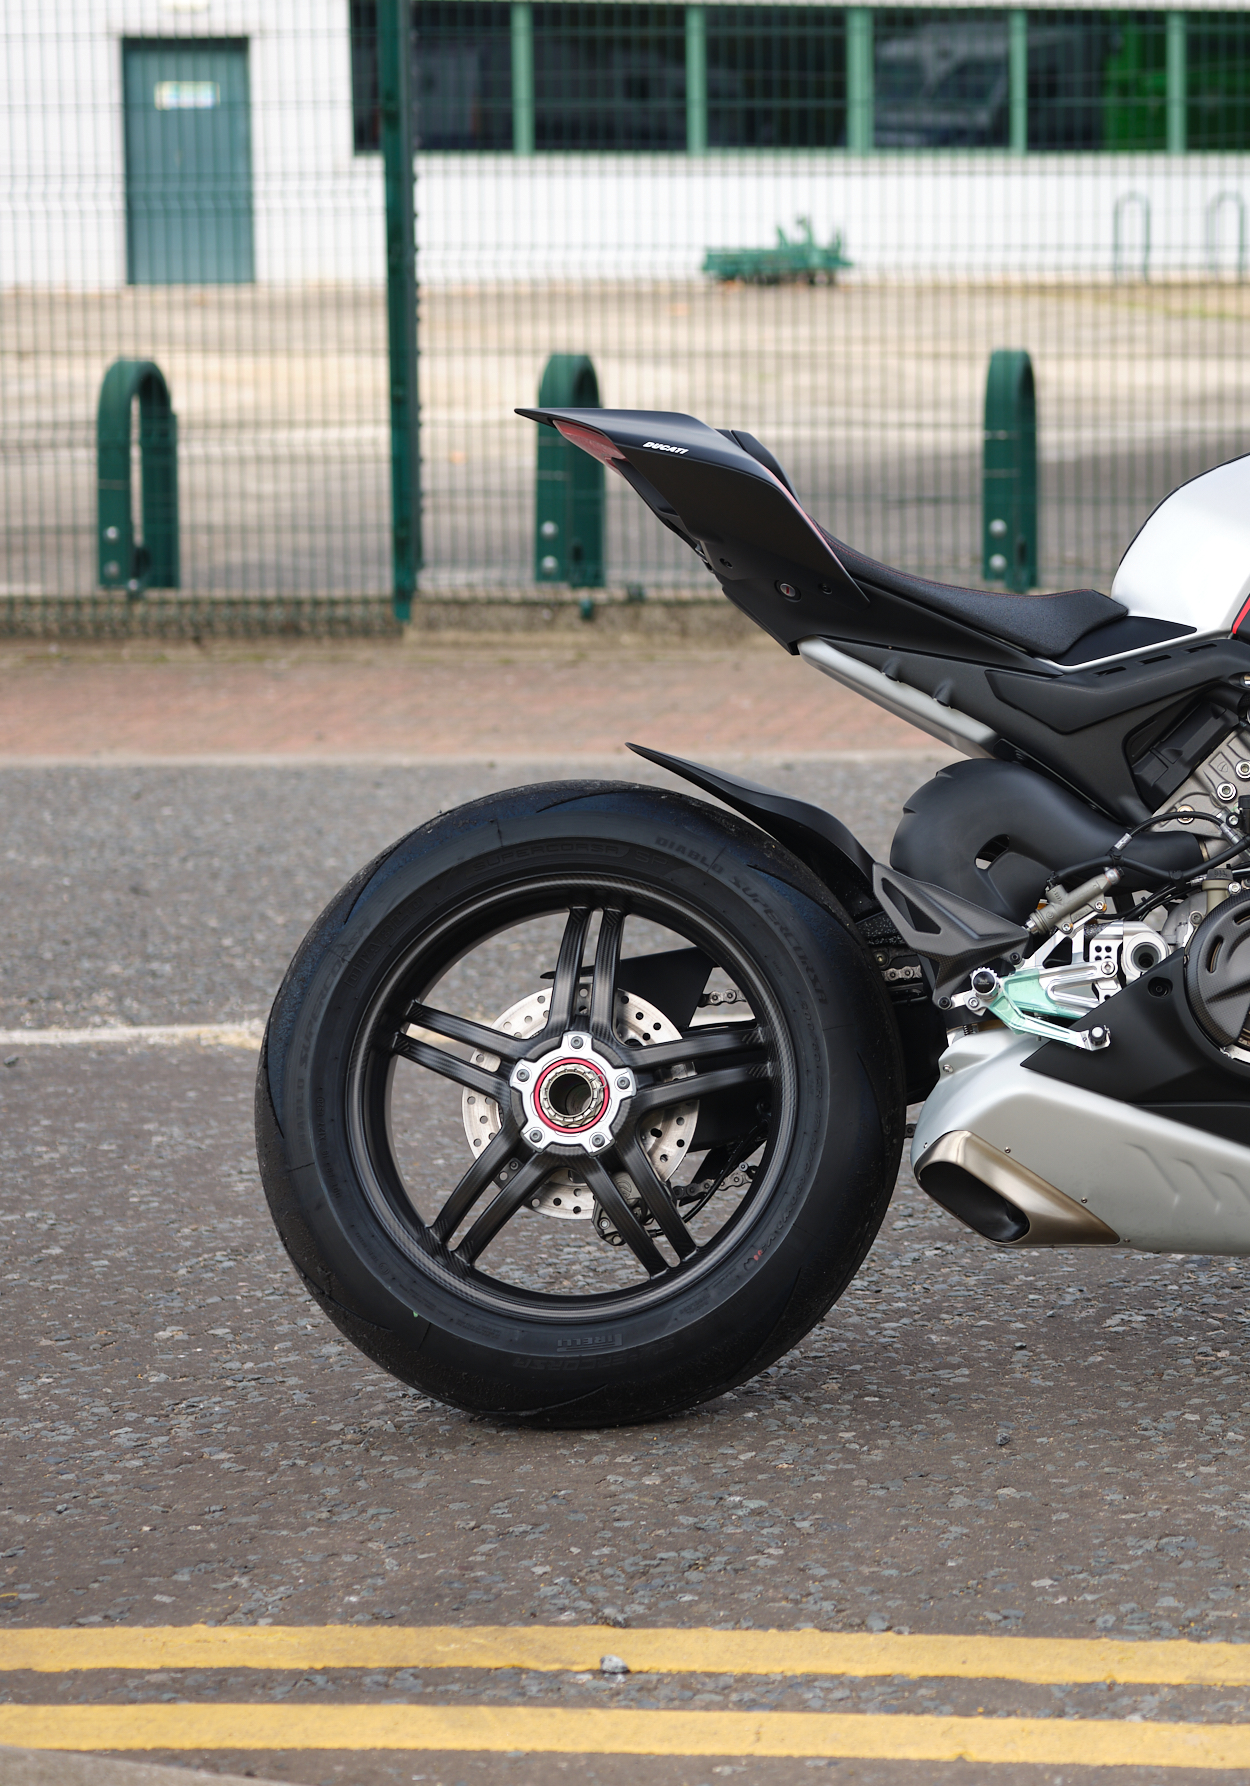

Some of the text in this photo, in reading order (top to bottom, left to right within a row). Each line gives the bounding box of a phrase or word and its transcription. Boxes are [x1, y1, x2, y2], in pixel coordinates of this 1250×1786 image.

[642, 441, 690, 455] DUCATI
[472, 842, 668, 872] SUPERCORSA SP
[654, 834, 725, 875] DIABLO
[343, 892, 428, 988] DIABLO
[555, 1332, 624, 1353] PIRELLI
